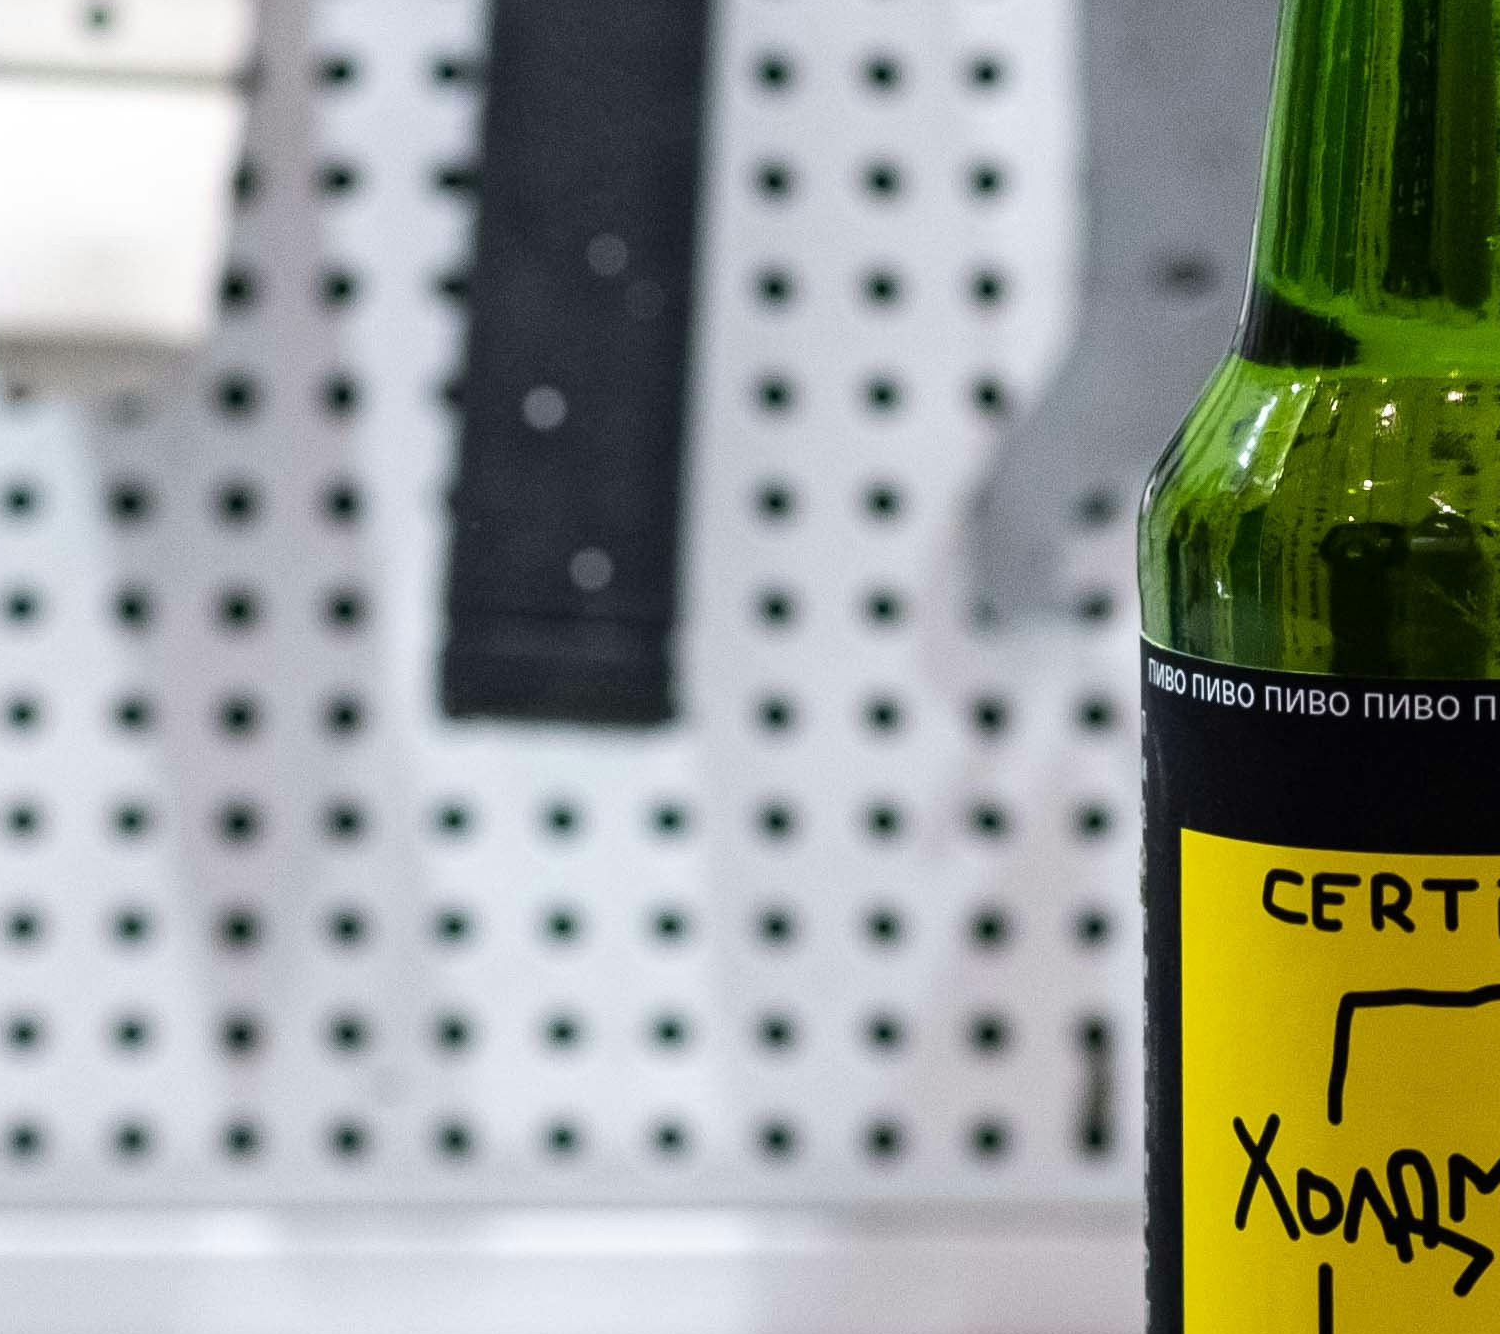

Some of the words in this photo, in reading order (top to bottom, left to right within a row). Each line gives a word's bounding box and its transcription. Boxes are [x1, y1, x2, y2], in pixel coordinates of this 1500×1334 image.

[1147, 657, 1187, 695] ПИВО
[1192, 673, 1255, 709] ПИВО
[1265, 685, 1350, 717] ПИВО
[1364, 692, 1460, 721] ПИВО
